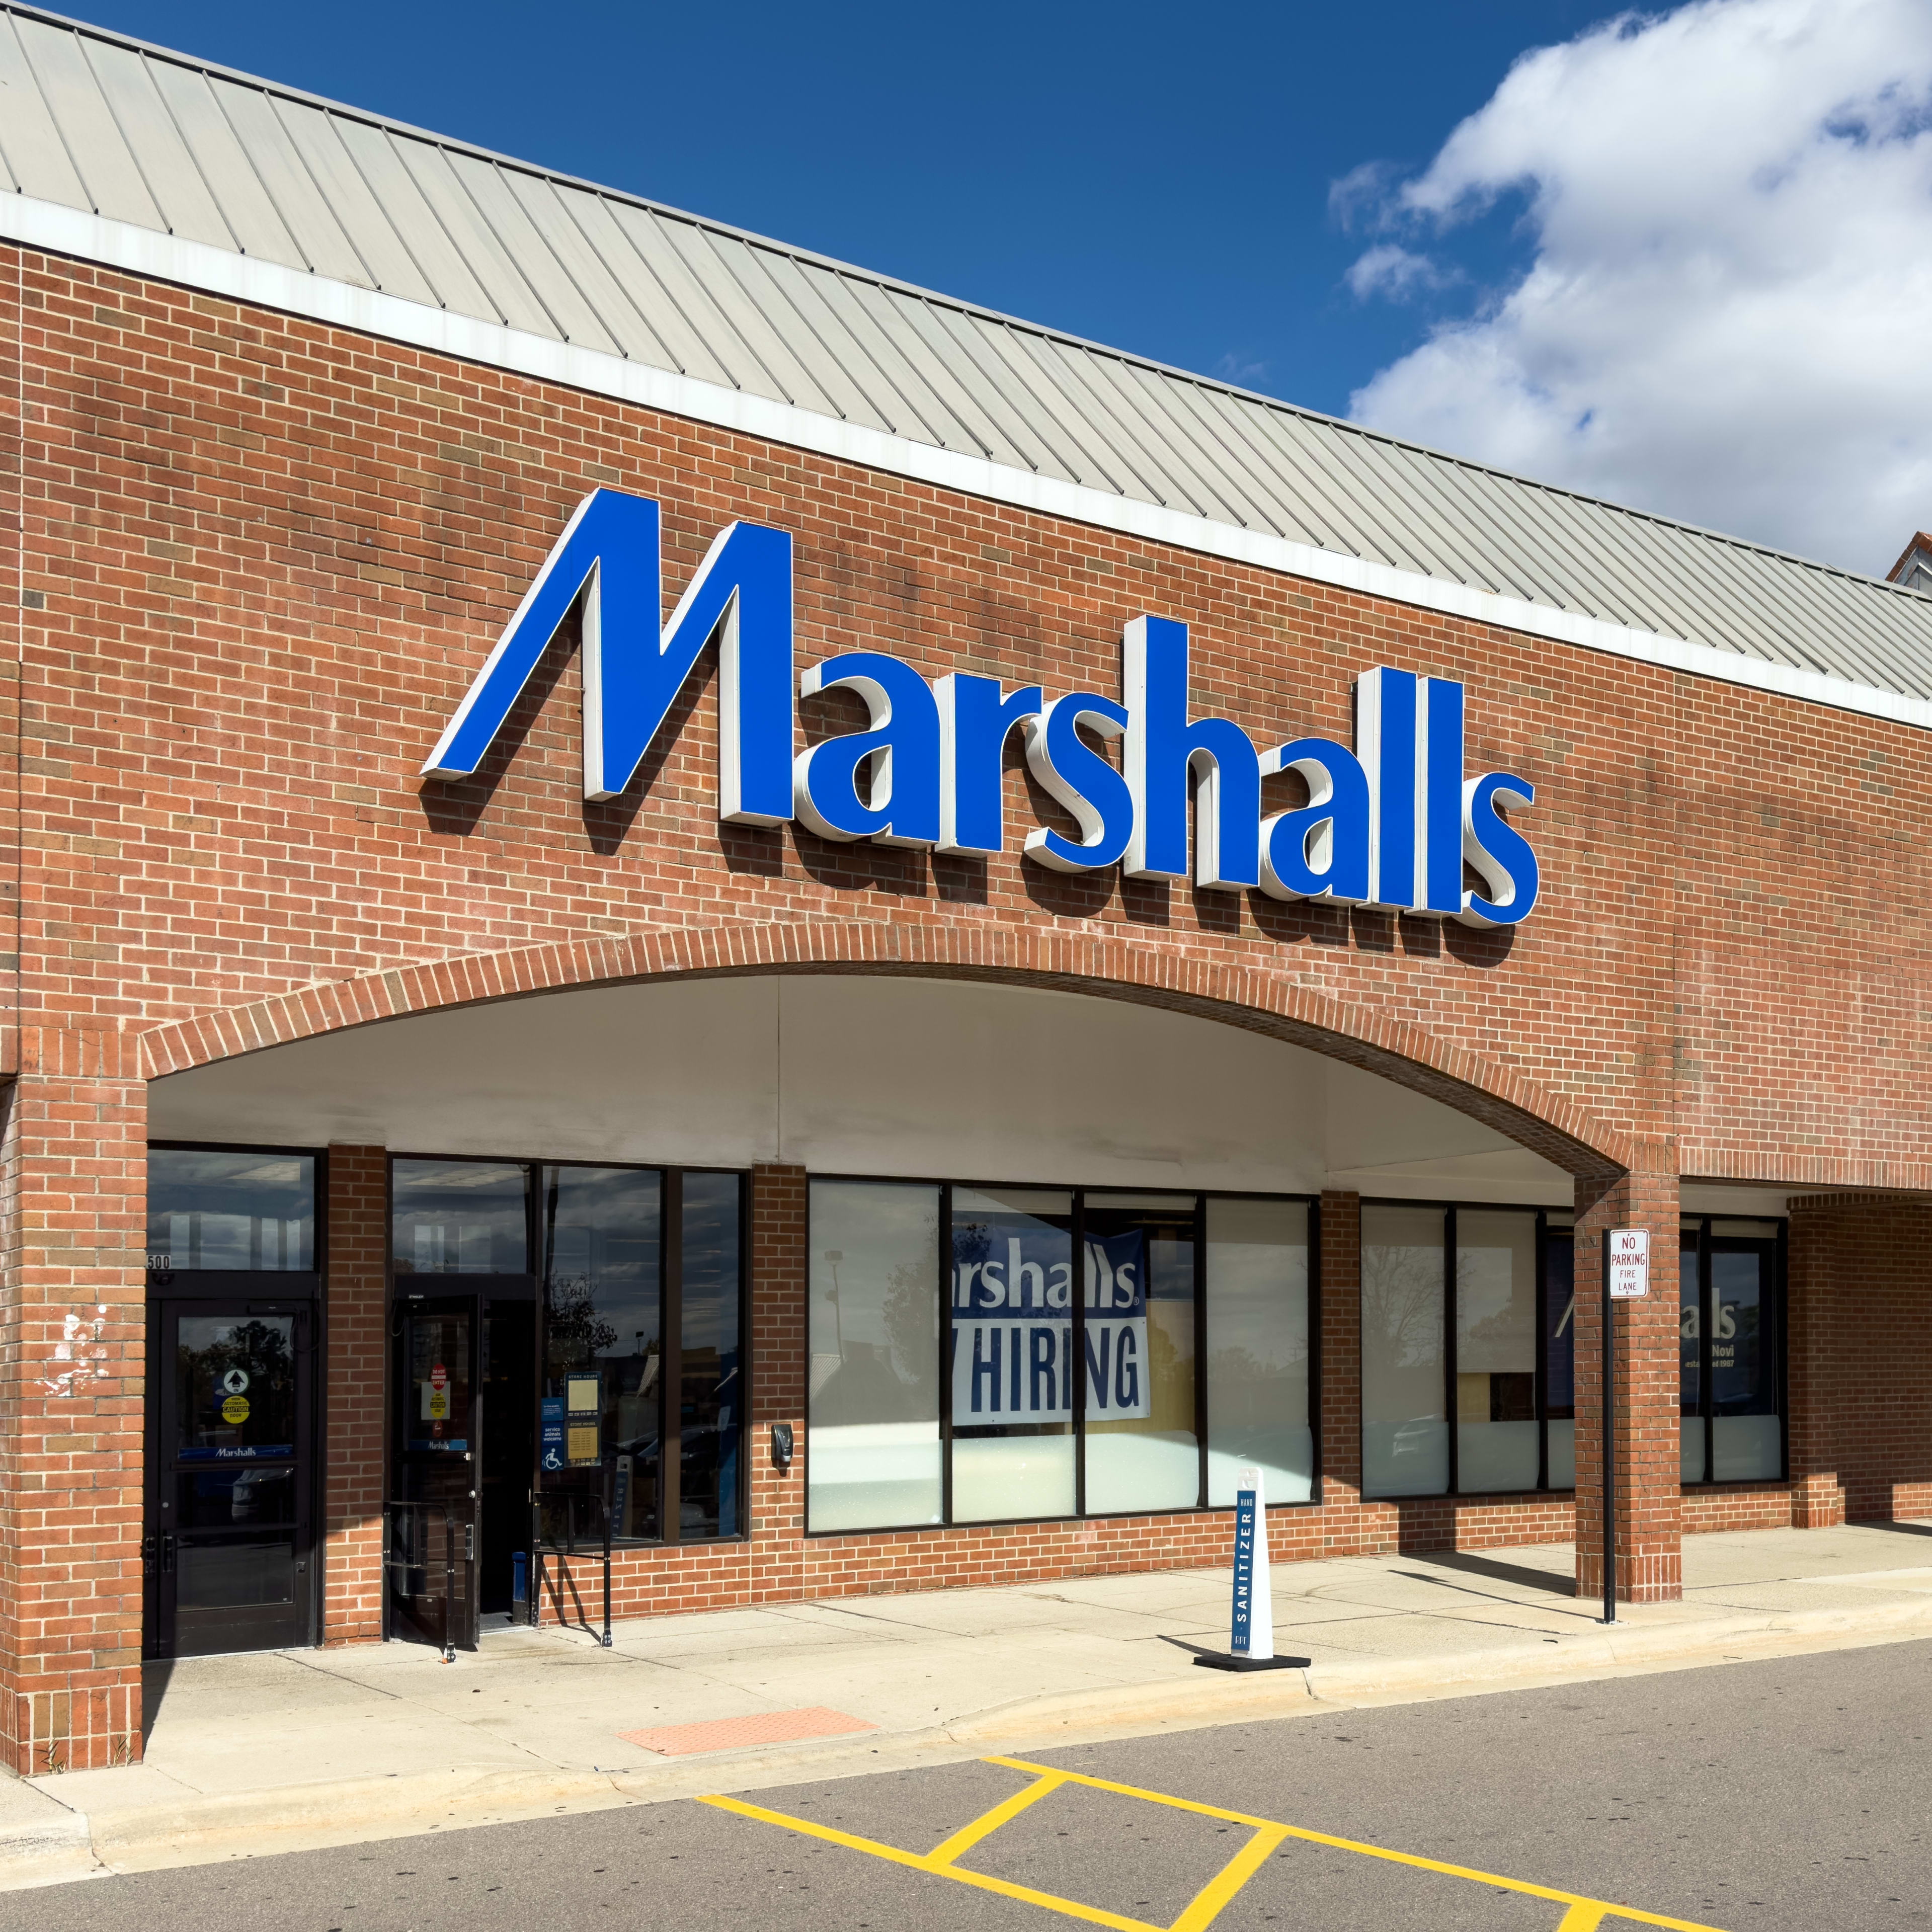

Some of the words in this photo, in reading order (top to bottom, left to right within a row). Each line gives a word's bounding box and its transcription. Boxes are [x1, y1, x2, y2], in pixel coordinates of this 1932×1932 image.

[420, 487, 1540, 930] Marshalls
[1622, 1237, 1635, 1249] NO
[148, 1255, 170, 1269] 500
[1612, 1253, 1645, 1266] PARKING
[952, 1238, 1136, 1308] rshalls
[1620, 1269, 1636, 1278] FIRE
[1619, 1282, 1637, 1291] LANE
[1712, 1344, 1734, 1357] Novi
[971, 1326, 1140, 1412] HIRING
[215, 1447, 256, 1457] Marshalls
[428, 1441, 449, 1450] Marshalls
[1237, 1513, 1252, 1623] SANITIZER
[1235, 1636, 1247, 1645] RPT
